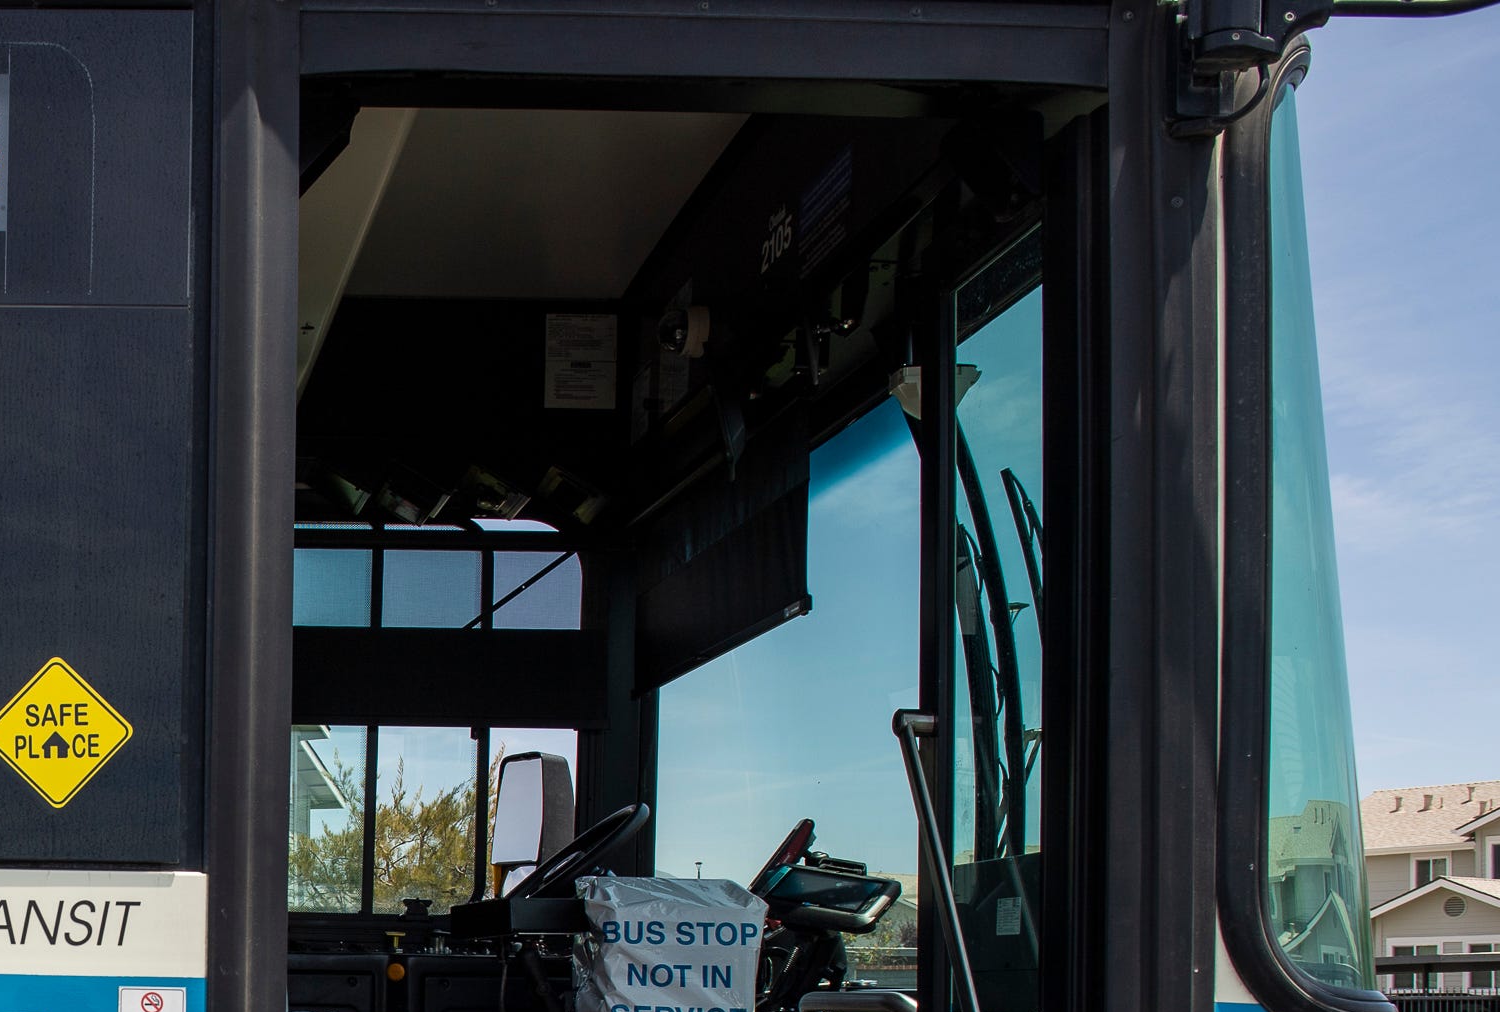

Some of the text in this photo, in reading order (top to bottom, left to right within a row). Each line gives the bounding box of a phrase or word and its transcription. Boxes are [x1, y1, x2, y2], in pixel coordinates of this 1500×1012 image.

[760, 214, 792, 275] 2105
[25, 703, 89, 727] SAFE
[602, 920, 758, 947] BUS STOP
[626, 964, 732, 989] NOT IN
